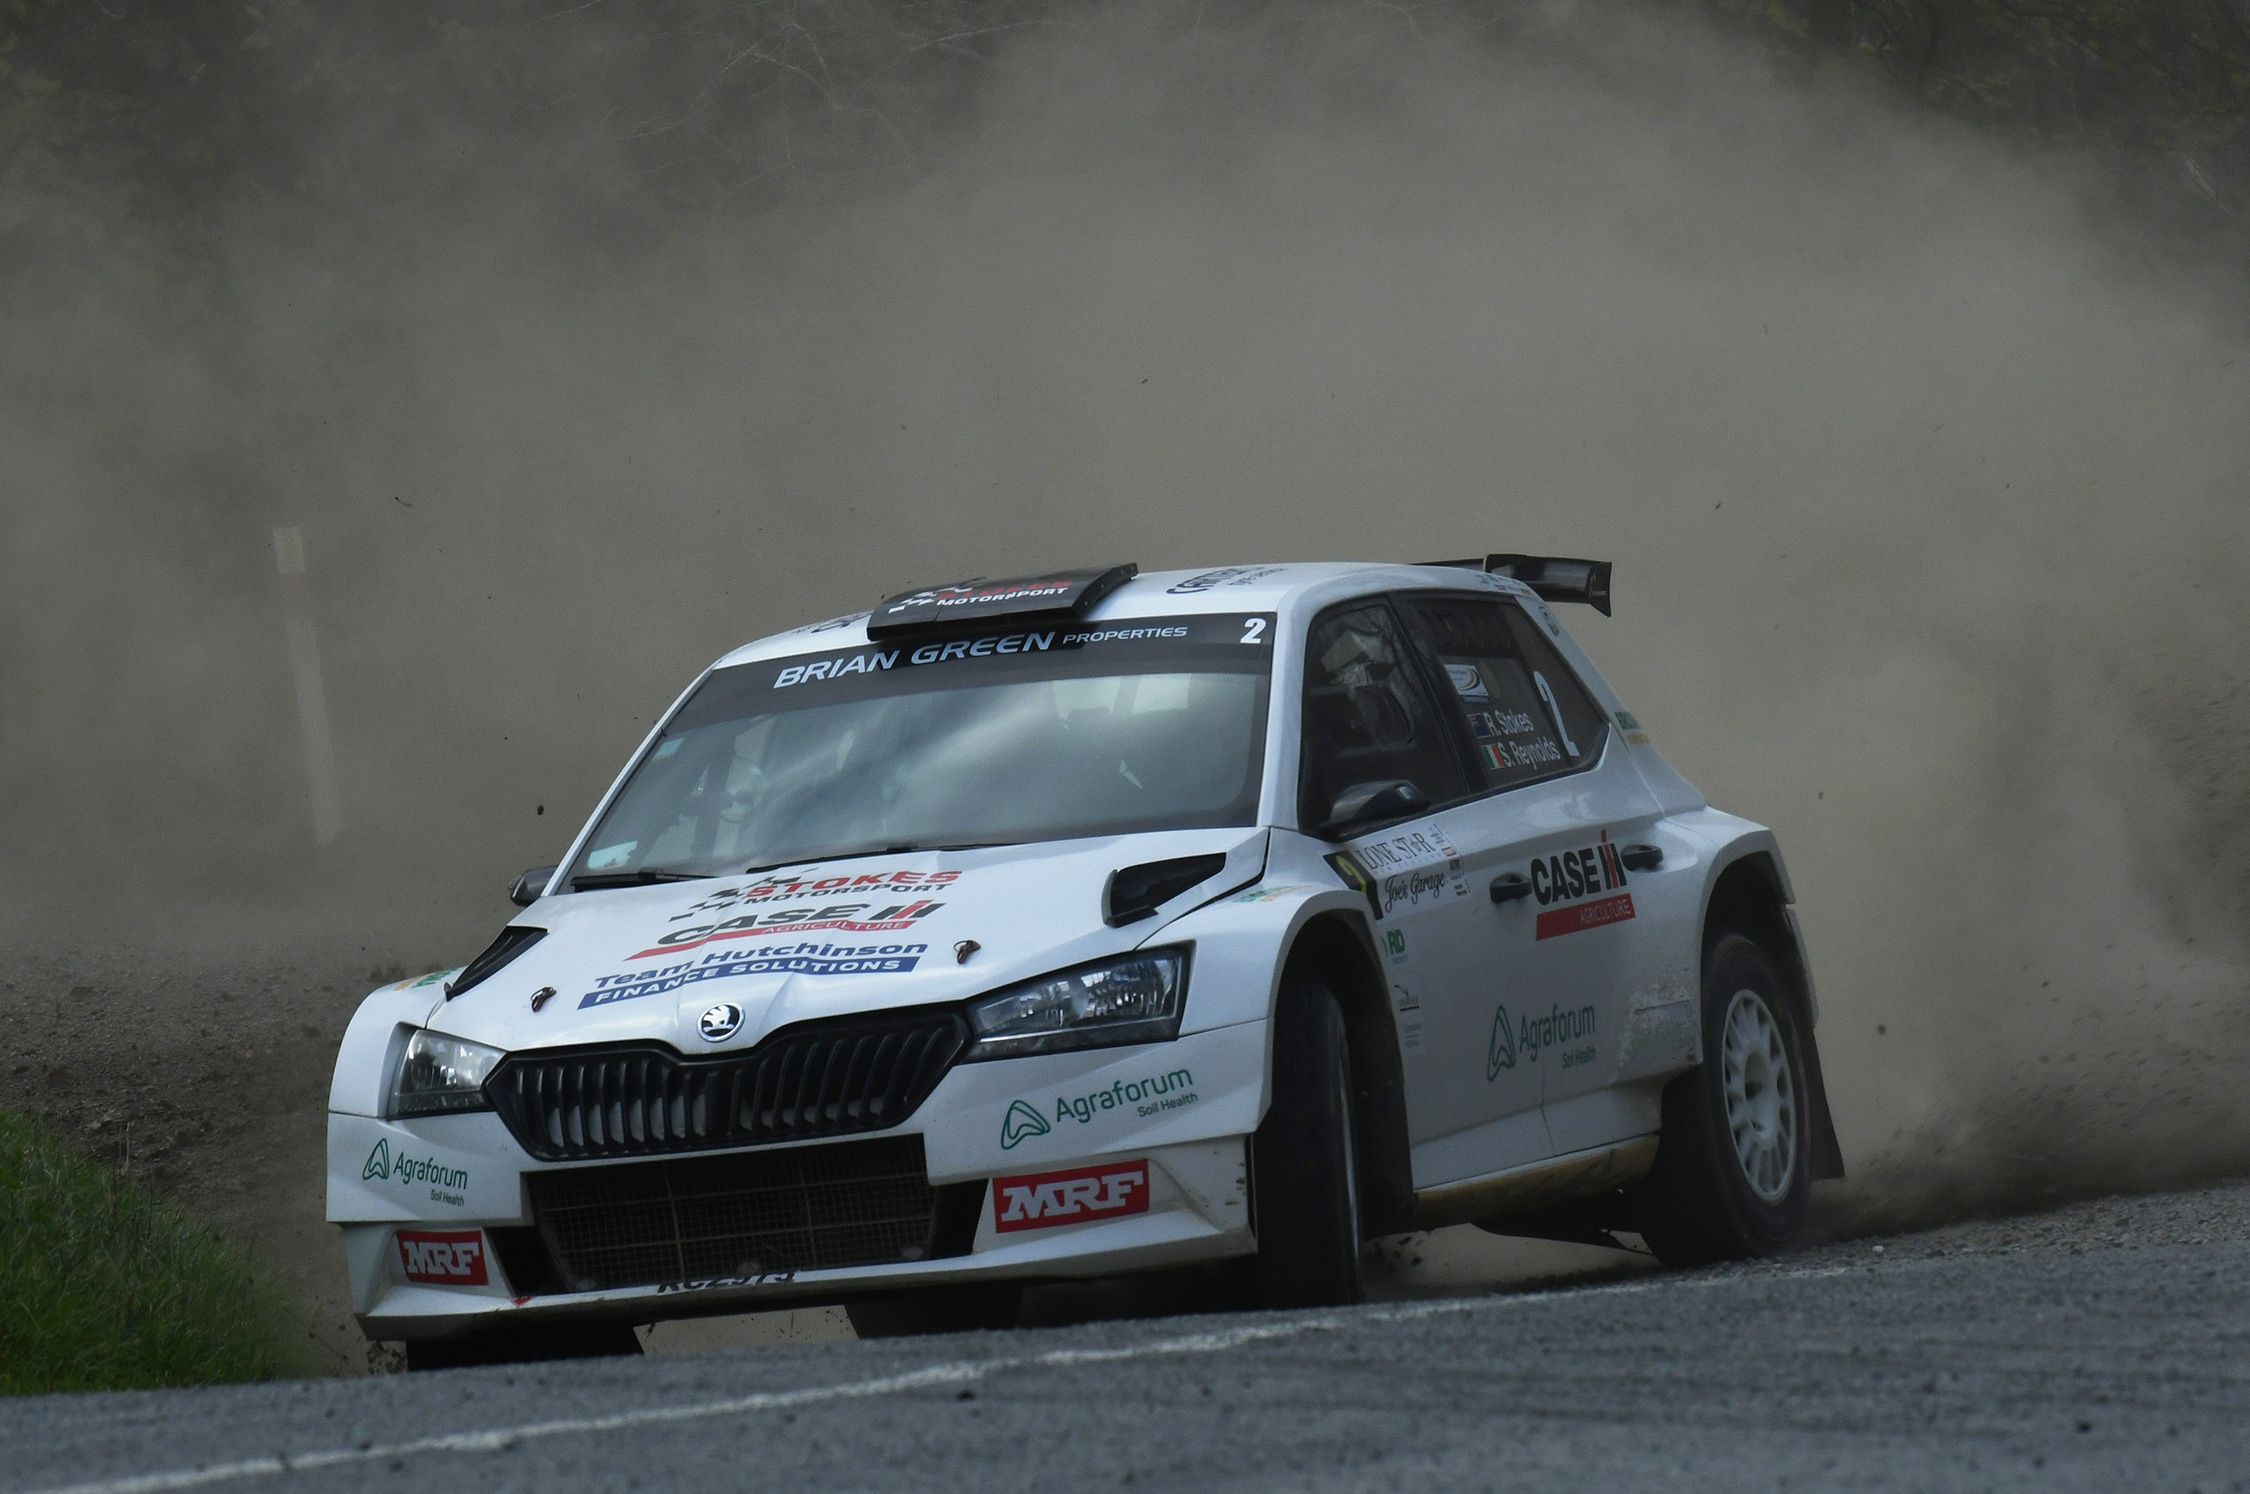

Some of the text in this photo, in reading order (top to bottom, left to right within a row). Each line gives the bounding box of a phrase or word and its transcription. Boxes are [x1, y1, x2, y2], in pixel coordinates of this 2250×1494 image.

[1240, 618, 1268, 644] 2
[773, 626, 1189, 689] BRIAN GREEN PROPERTIES
[1484, 709, 1535, 737] R. Stokes
[1498, 736, 1561, 770] S. Reynolds
[1355, 842, 1402, 870] LONE
[744, 870, 963, 898] STOKES
[1410, 872, 1446, 905] Garage
[1531, 848, 1601, 905] CASE
[745, 883, 955, 905] MOTORSPORT
[657, 903, 871, 946] CASE
[761, 920, 904, 936] AGRICULTURE
[1580, 899, 1632, 924] AGRICULTURE
[594, 942, 928, 990] Team Hutchinson
[594, 960, 901, 1004] FINANCE SOLUTIONS
[1519, 1004, 1596, 1063] Agraforum
[1056, 1068, 1193, 1124] Agraforum
[1137, 1092, 1198, 1118] Soil Health
[393, 1151, 469, 1190] Agraforum
[430, 1189, 465, 1207] Soil Health
[1001, 1170, 1145, 1222] MRF
[403, 1241, 480, 1276] MRF
